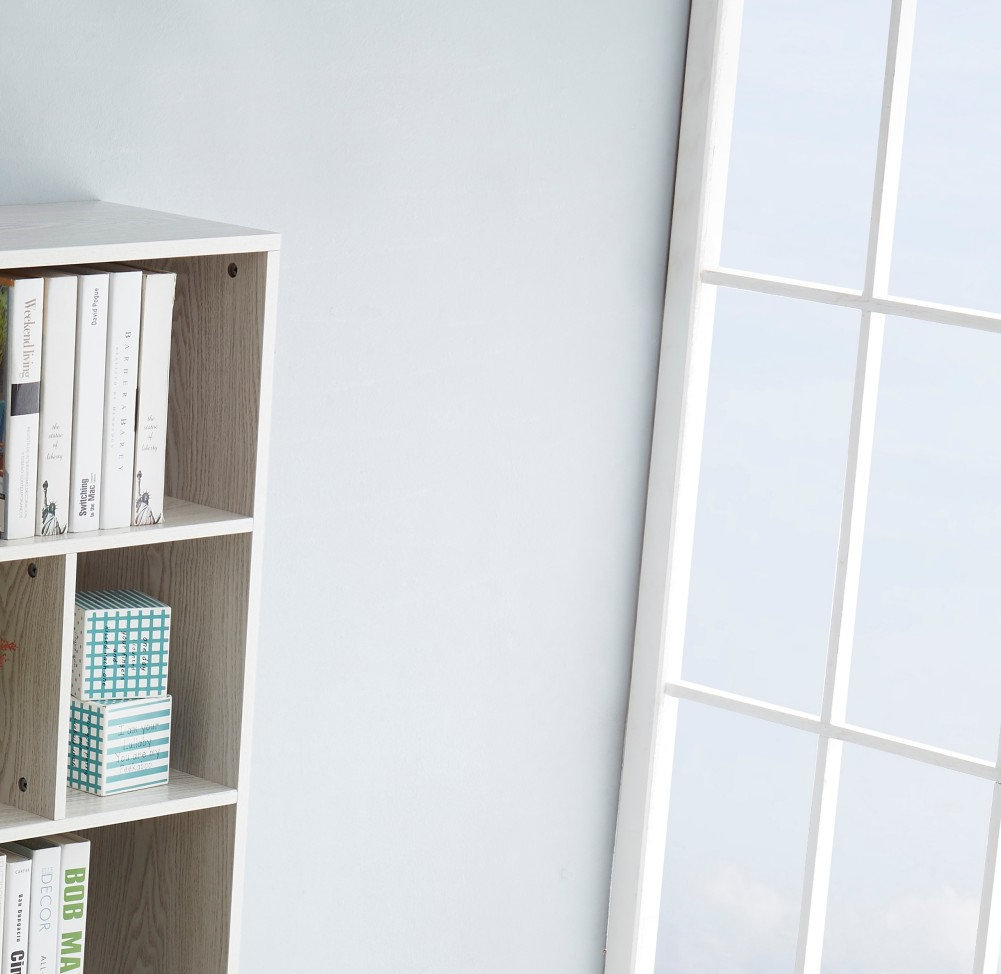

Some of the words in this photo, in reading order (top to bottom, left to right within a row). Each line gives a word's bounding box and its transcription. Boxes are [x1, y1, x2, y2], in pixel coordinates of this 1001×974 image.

[23, 298, 37, 348] Weekend
[78, 478, 89, 517] Switching
[88, 485, 96, 502] Mac
[39, 874, 53, 932] DECOR
[63, 867, 86, 920] BOB
